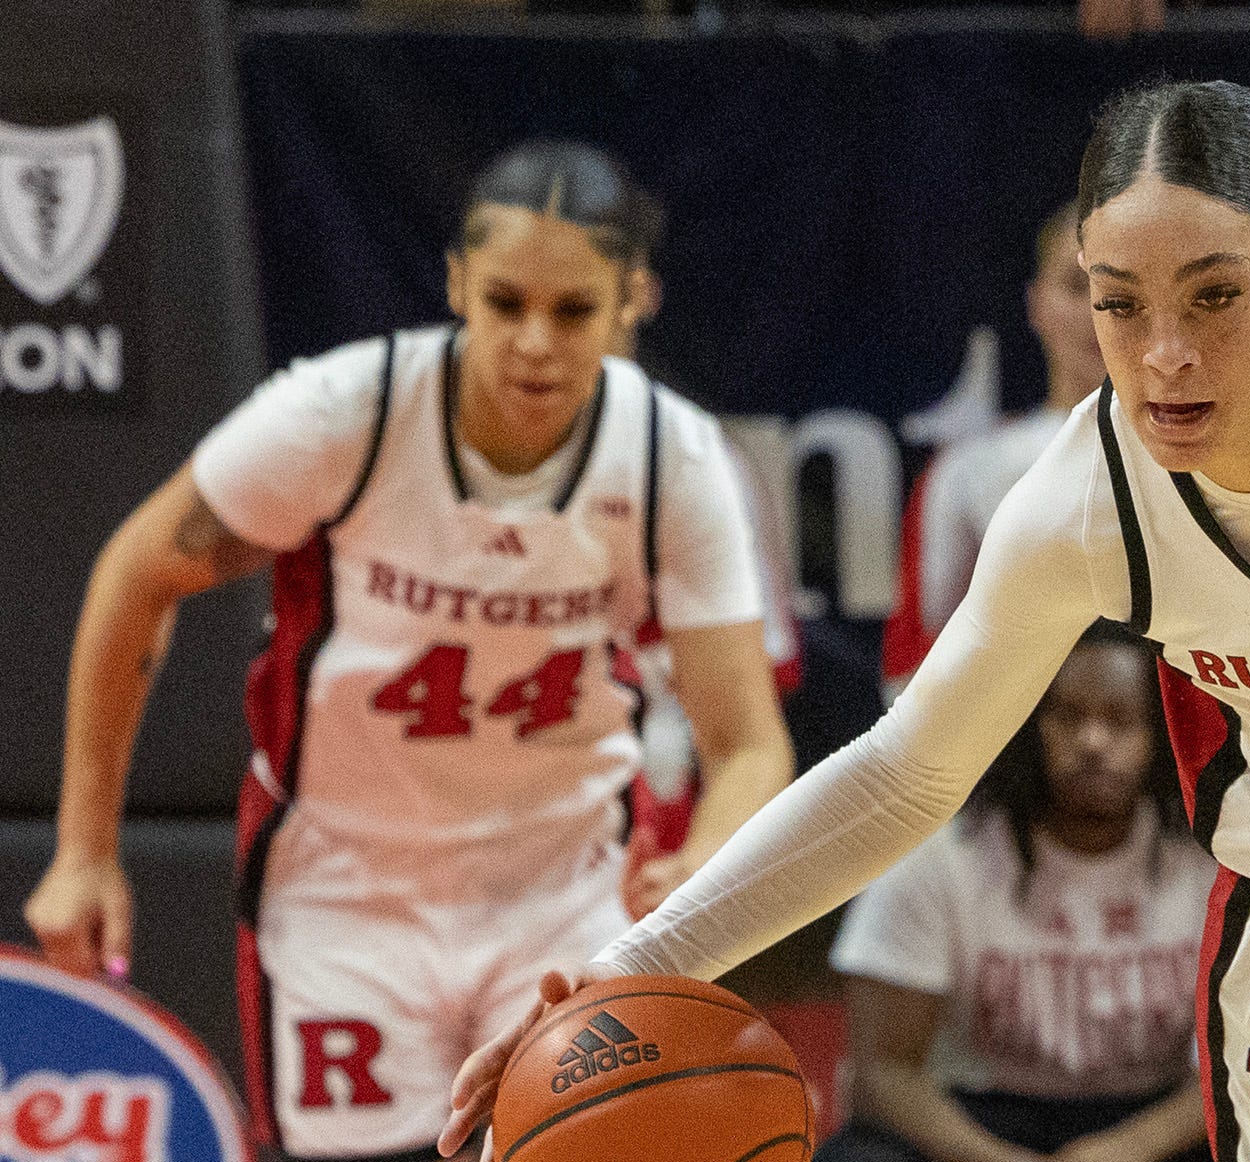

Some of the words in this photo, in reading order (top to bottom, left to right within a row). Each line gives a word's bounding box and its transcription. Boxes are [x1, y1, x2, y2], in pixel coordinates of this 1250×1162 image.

[370, 642, 584, 741] 44
[295, 1017, 393, 1107] R
[551, 1042, 662, 1094] adidas
